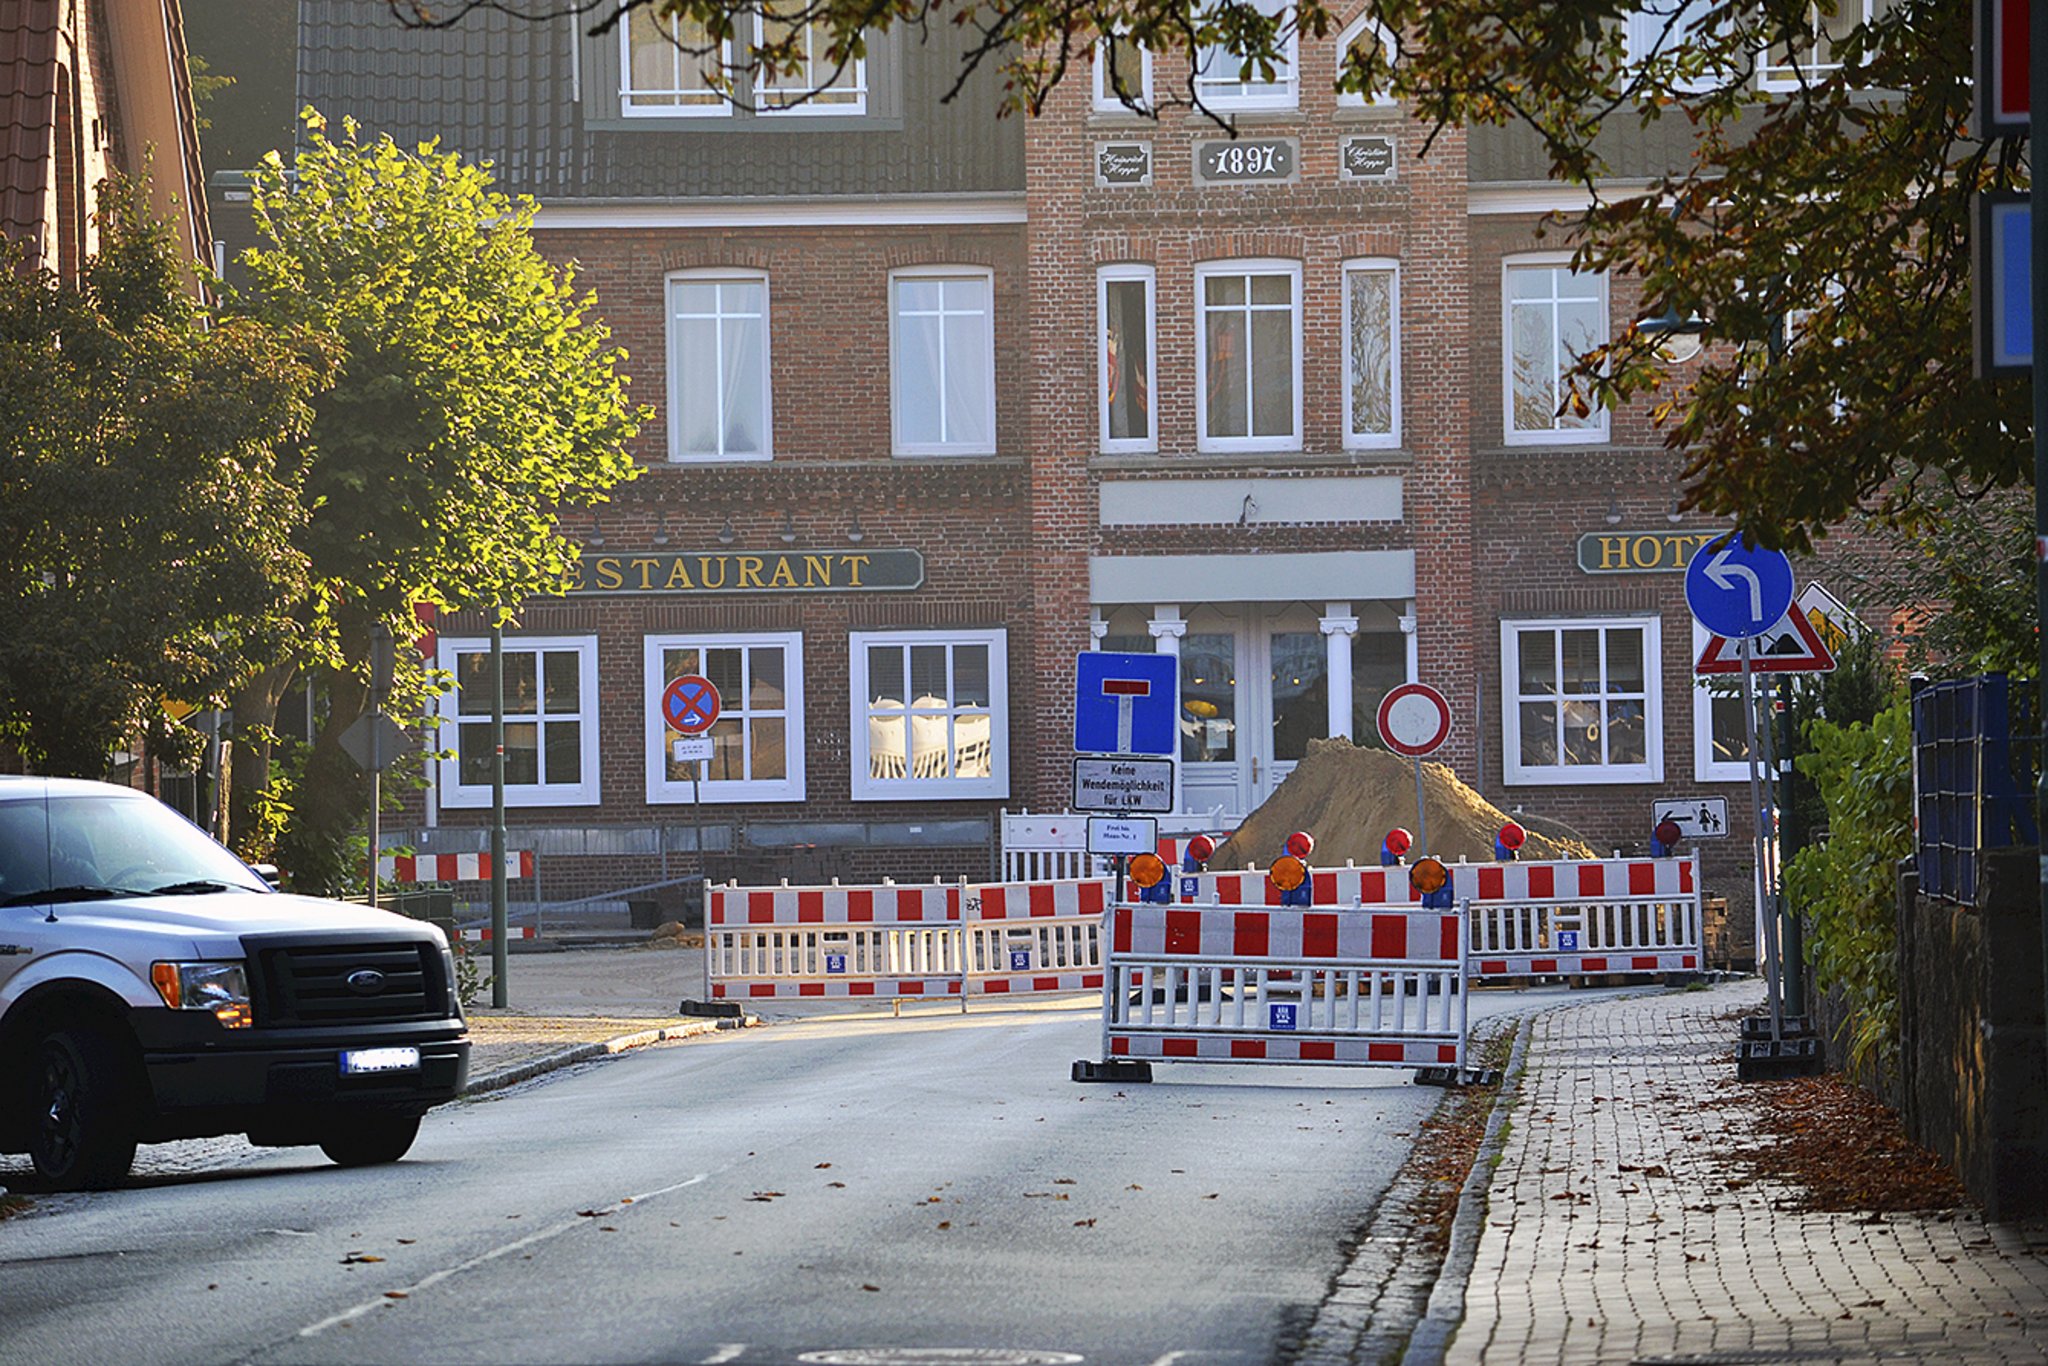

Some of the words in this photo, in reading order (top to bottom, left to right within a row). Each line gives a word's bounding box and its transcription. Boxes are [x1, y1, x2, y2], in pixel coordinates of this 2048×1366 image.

[1598, 534, 1716, 569] HOT
[537, 555, 871, 590] ESTAURANT
[1111, 764, 1136, 776] Keine
[1082, 779, 1165, 793] Wendemöglichkeit
[1103, 794, 1118, 805] für
[1121, 795, 1142, 806] LKW
